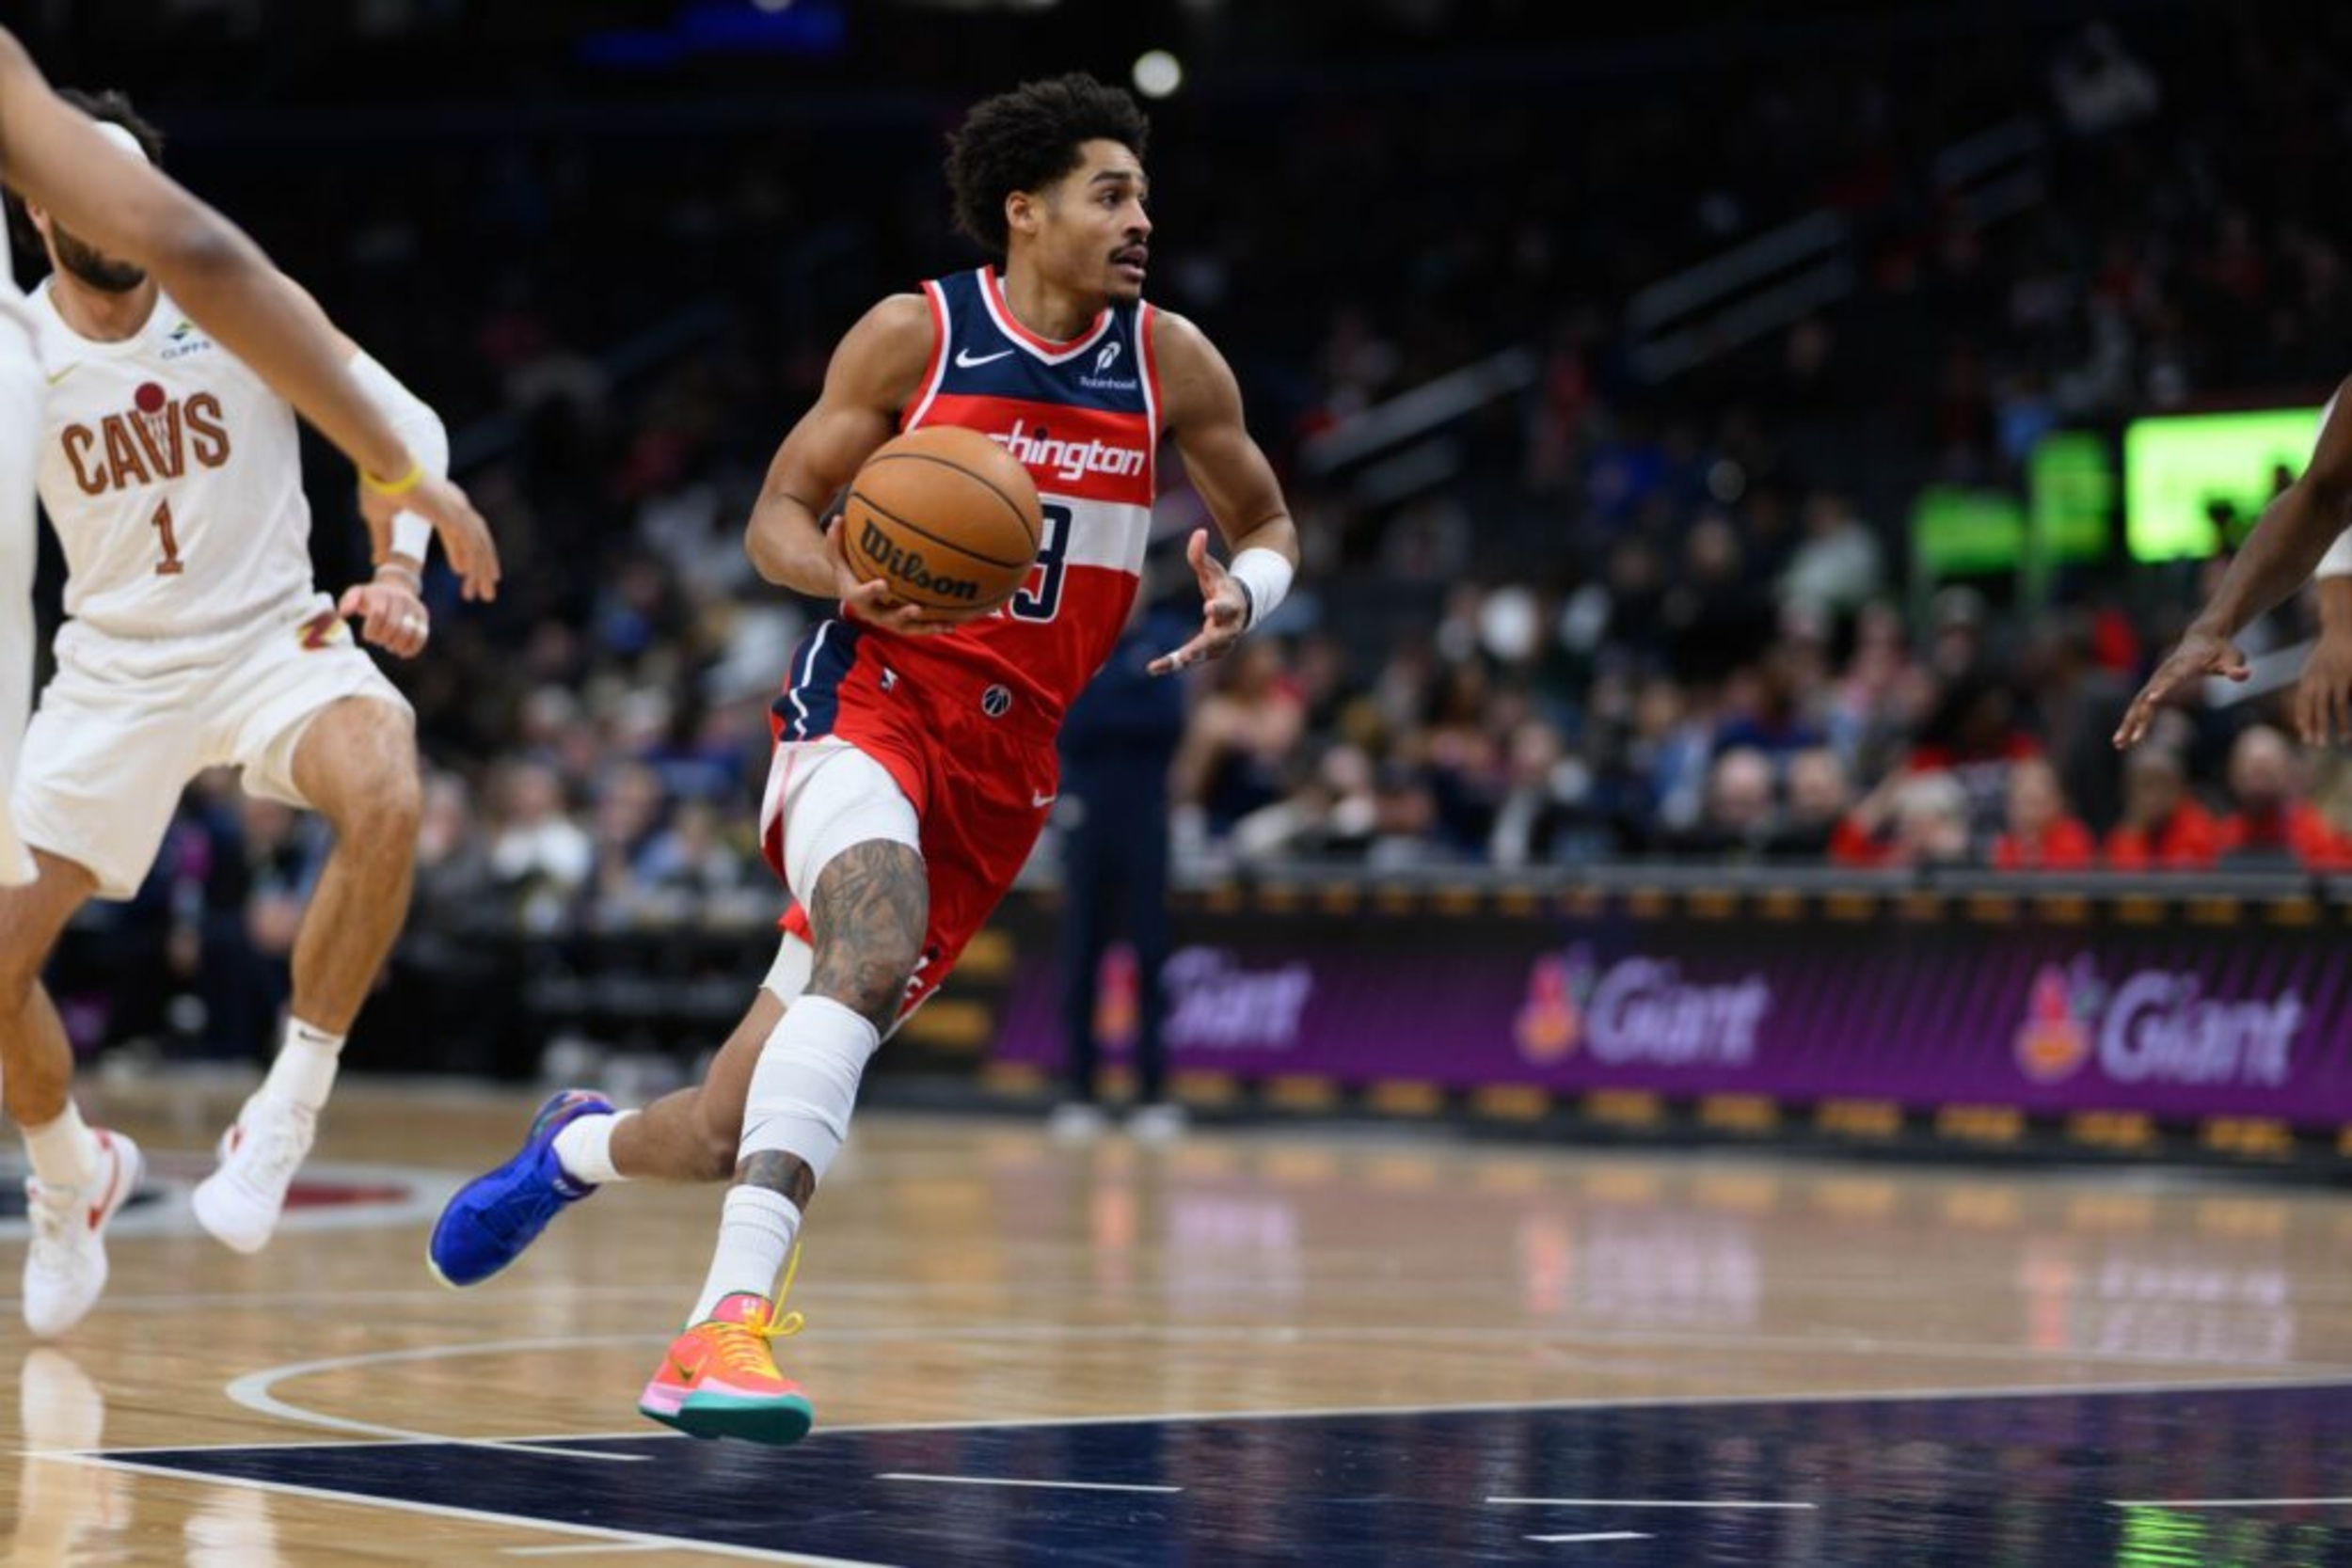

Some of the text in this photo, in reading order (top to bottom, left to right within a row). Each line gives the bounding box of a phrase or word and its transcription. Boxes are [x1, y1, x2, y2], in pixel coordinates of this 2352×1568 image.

[60, 391, 230, 496] CAVS
[988, 420, 1144, 481] hington
[151, 498, 183, 575] 1
[860, 518, 979, 600] Wilson
[993, 499, 1073, 624] 3
[1589, 953, 1769, 1066] Giant
[2098, 970, 2303, 1085] Giant
